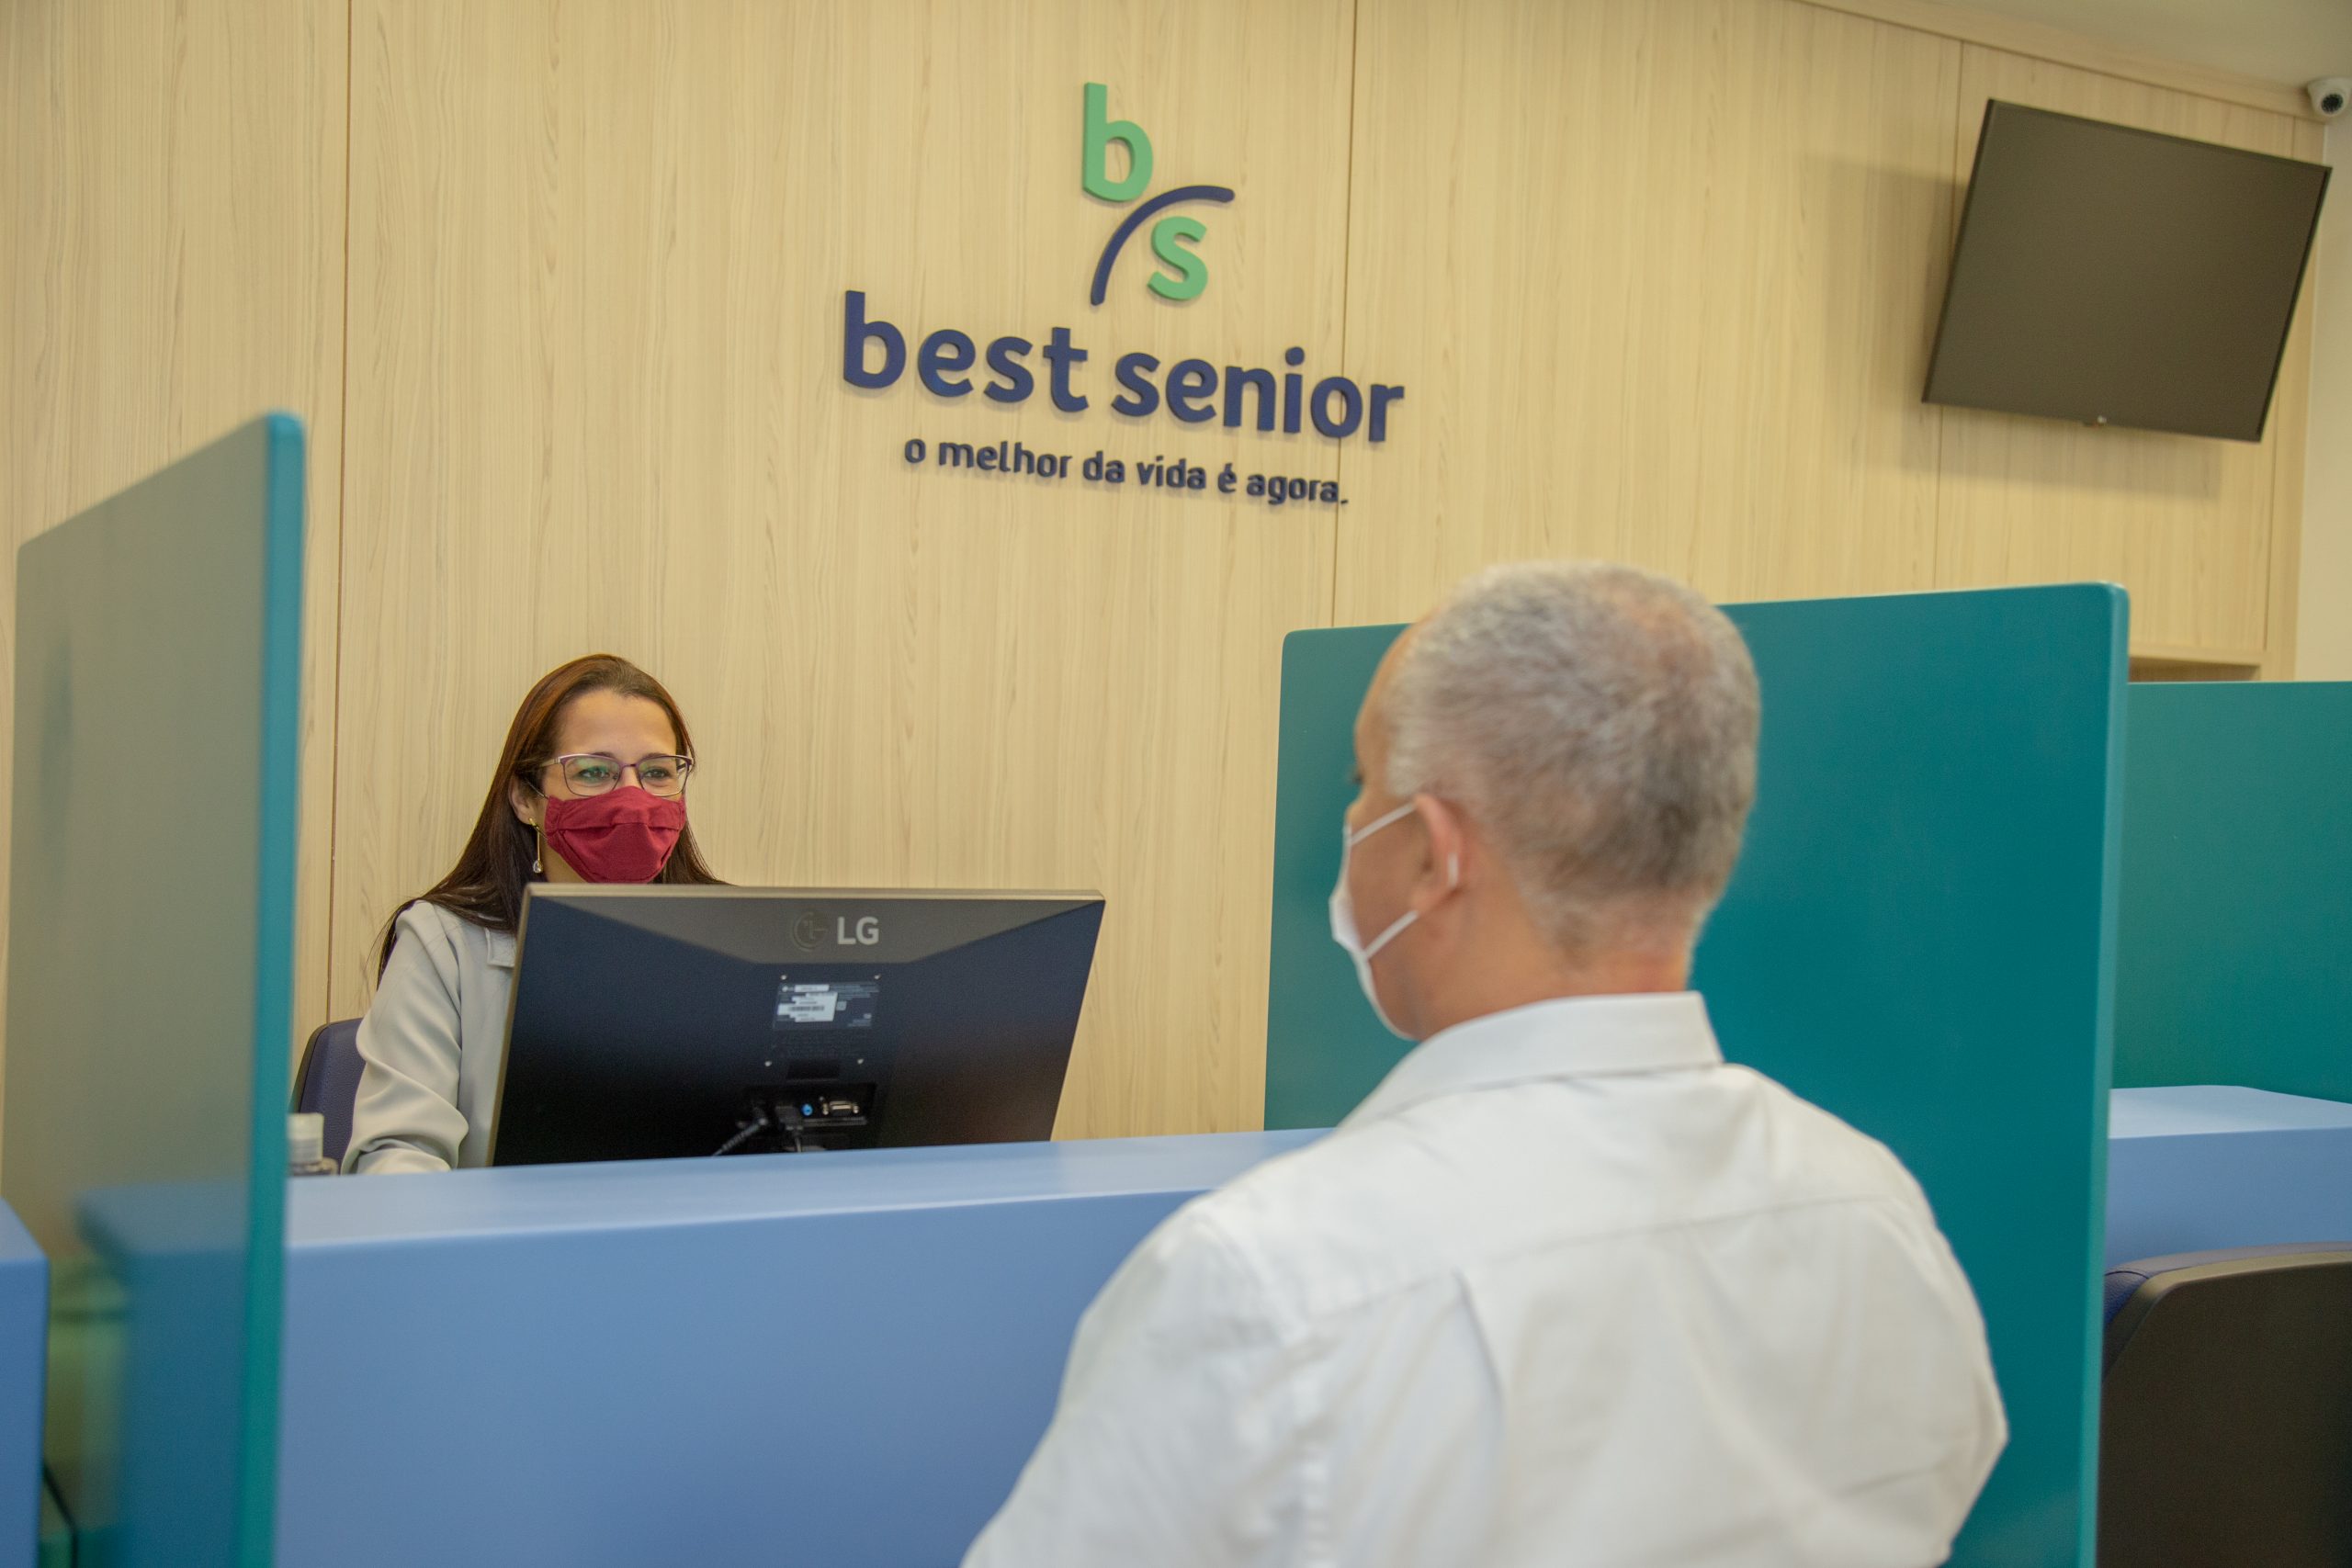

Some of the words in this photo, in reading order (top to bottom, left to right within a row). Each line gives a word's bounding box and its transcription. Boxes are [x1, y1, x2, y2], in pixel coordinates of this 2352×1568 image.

[1082, 82, 1154, 202] b
[1148, 216, 1209, 300] s
[843, 289, 1090, 413] best
[1111, 346, 1406, 443] senior
[904, 438, 926, 464] o
[938, 441, 1073, 479] melhor
[1082, 450, 1125, 484] da
[1136, 455, 1206, 491] vida
[1217, 463, 1238, 494] é
[1246, 473, 1348, 506] agora.
[837, 917, 879, 945] LG
